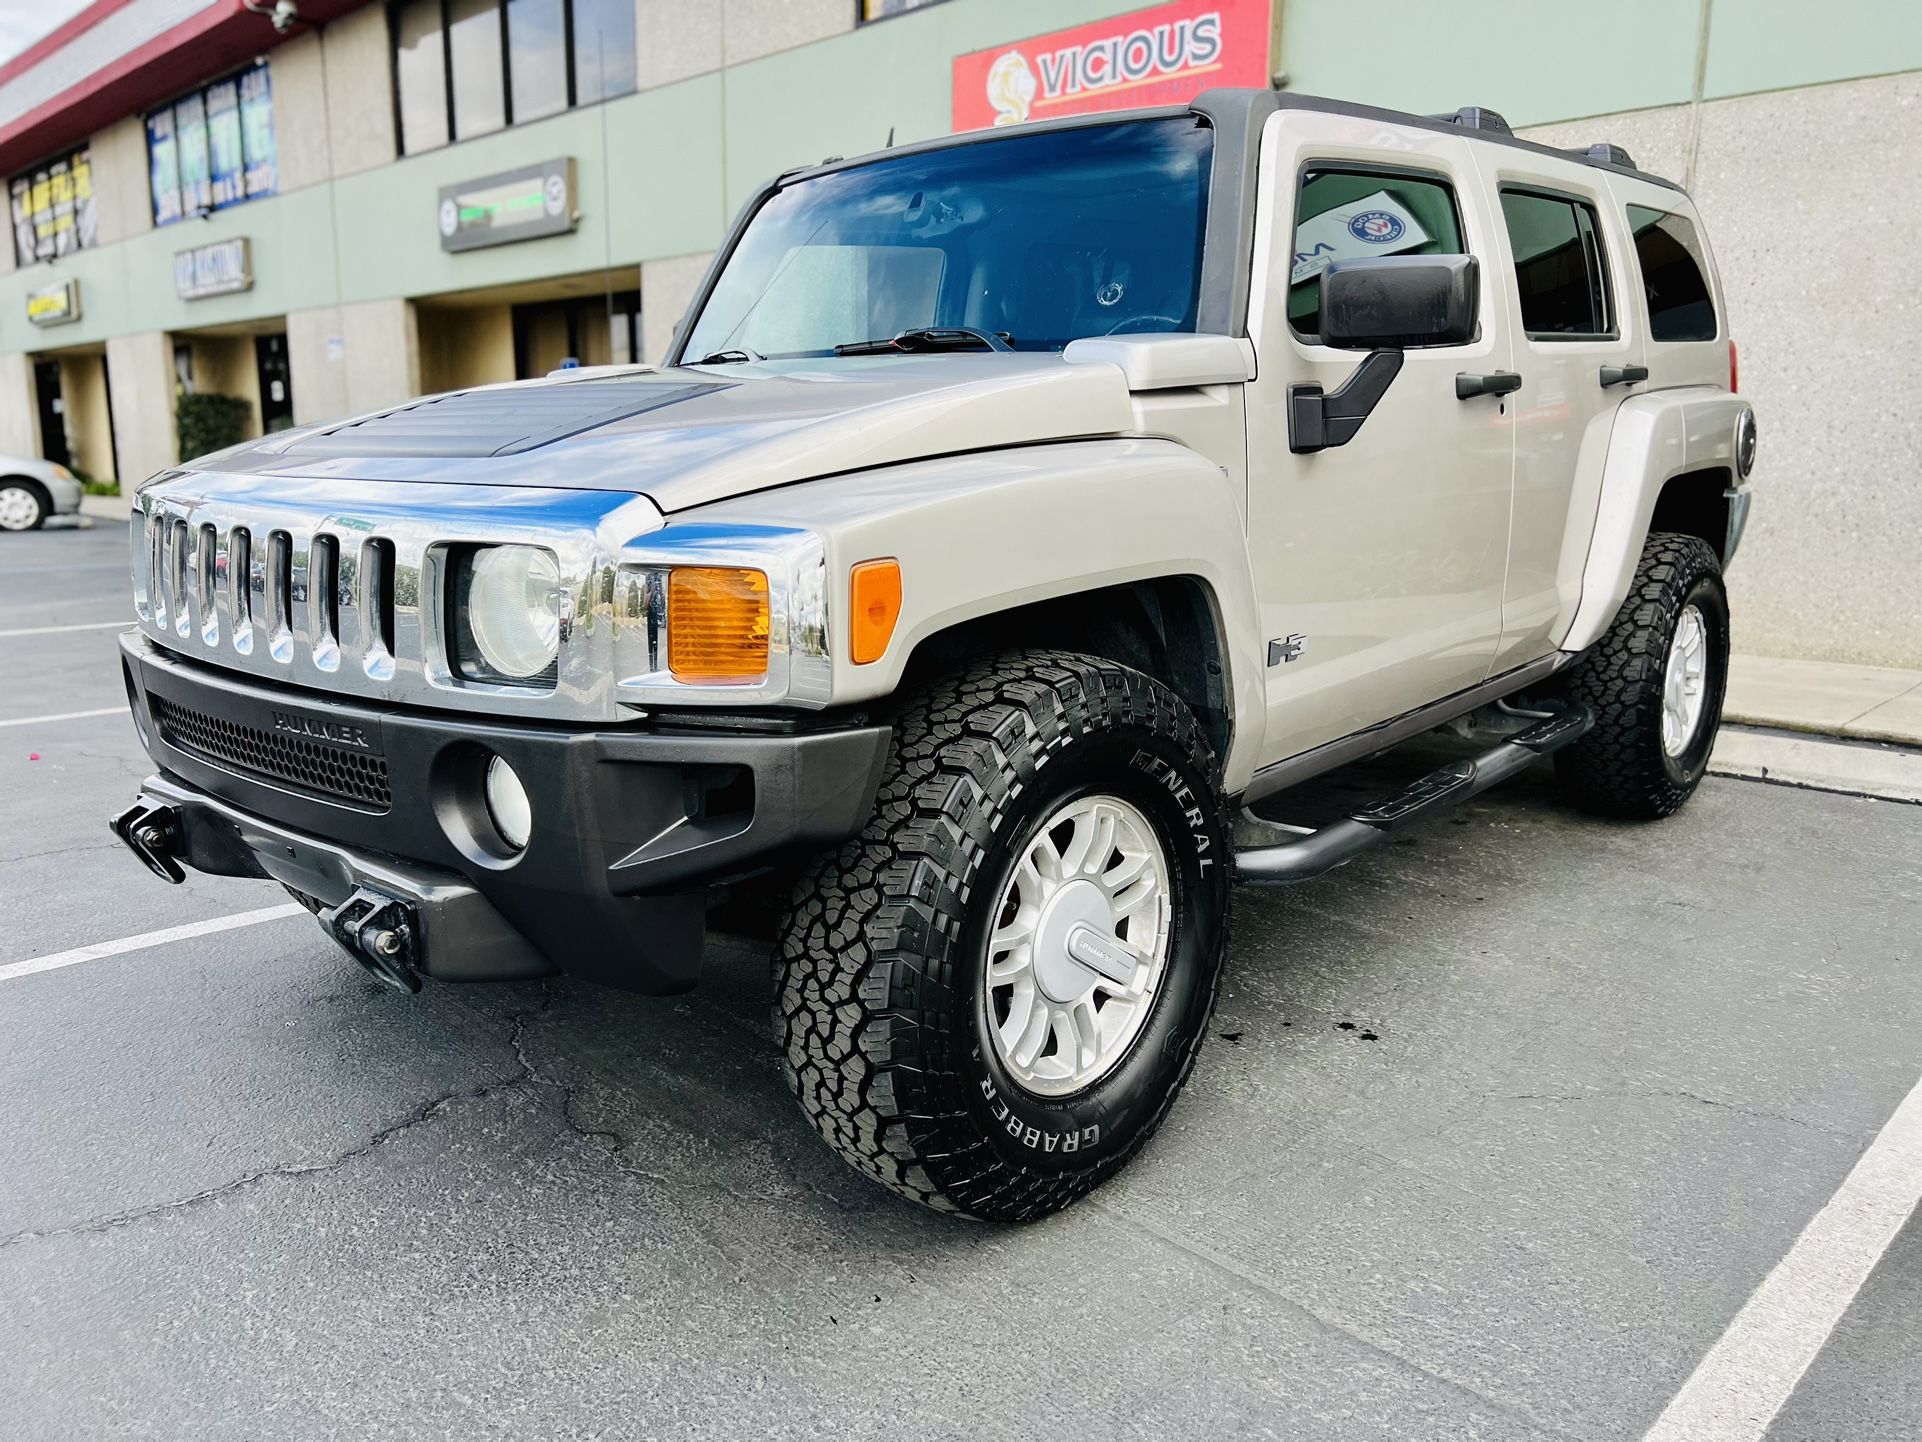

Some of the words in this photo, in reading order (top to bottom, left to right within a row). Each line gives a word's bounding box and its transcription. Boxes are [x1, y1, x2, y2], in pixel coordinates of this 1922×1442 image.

[1036, 12, 1222, 98] VICIOUS
[271, 710, 369, 748] HUMMER
[979, 1072, 1101, 1153] GRABBER
